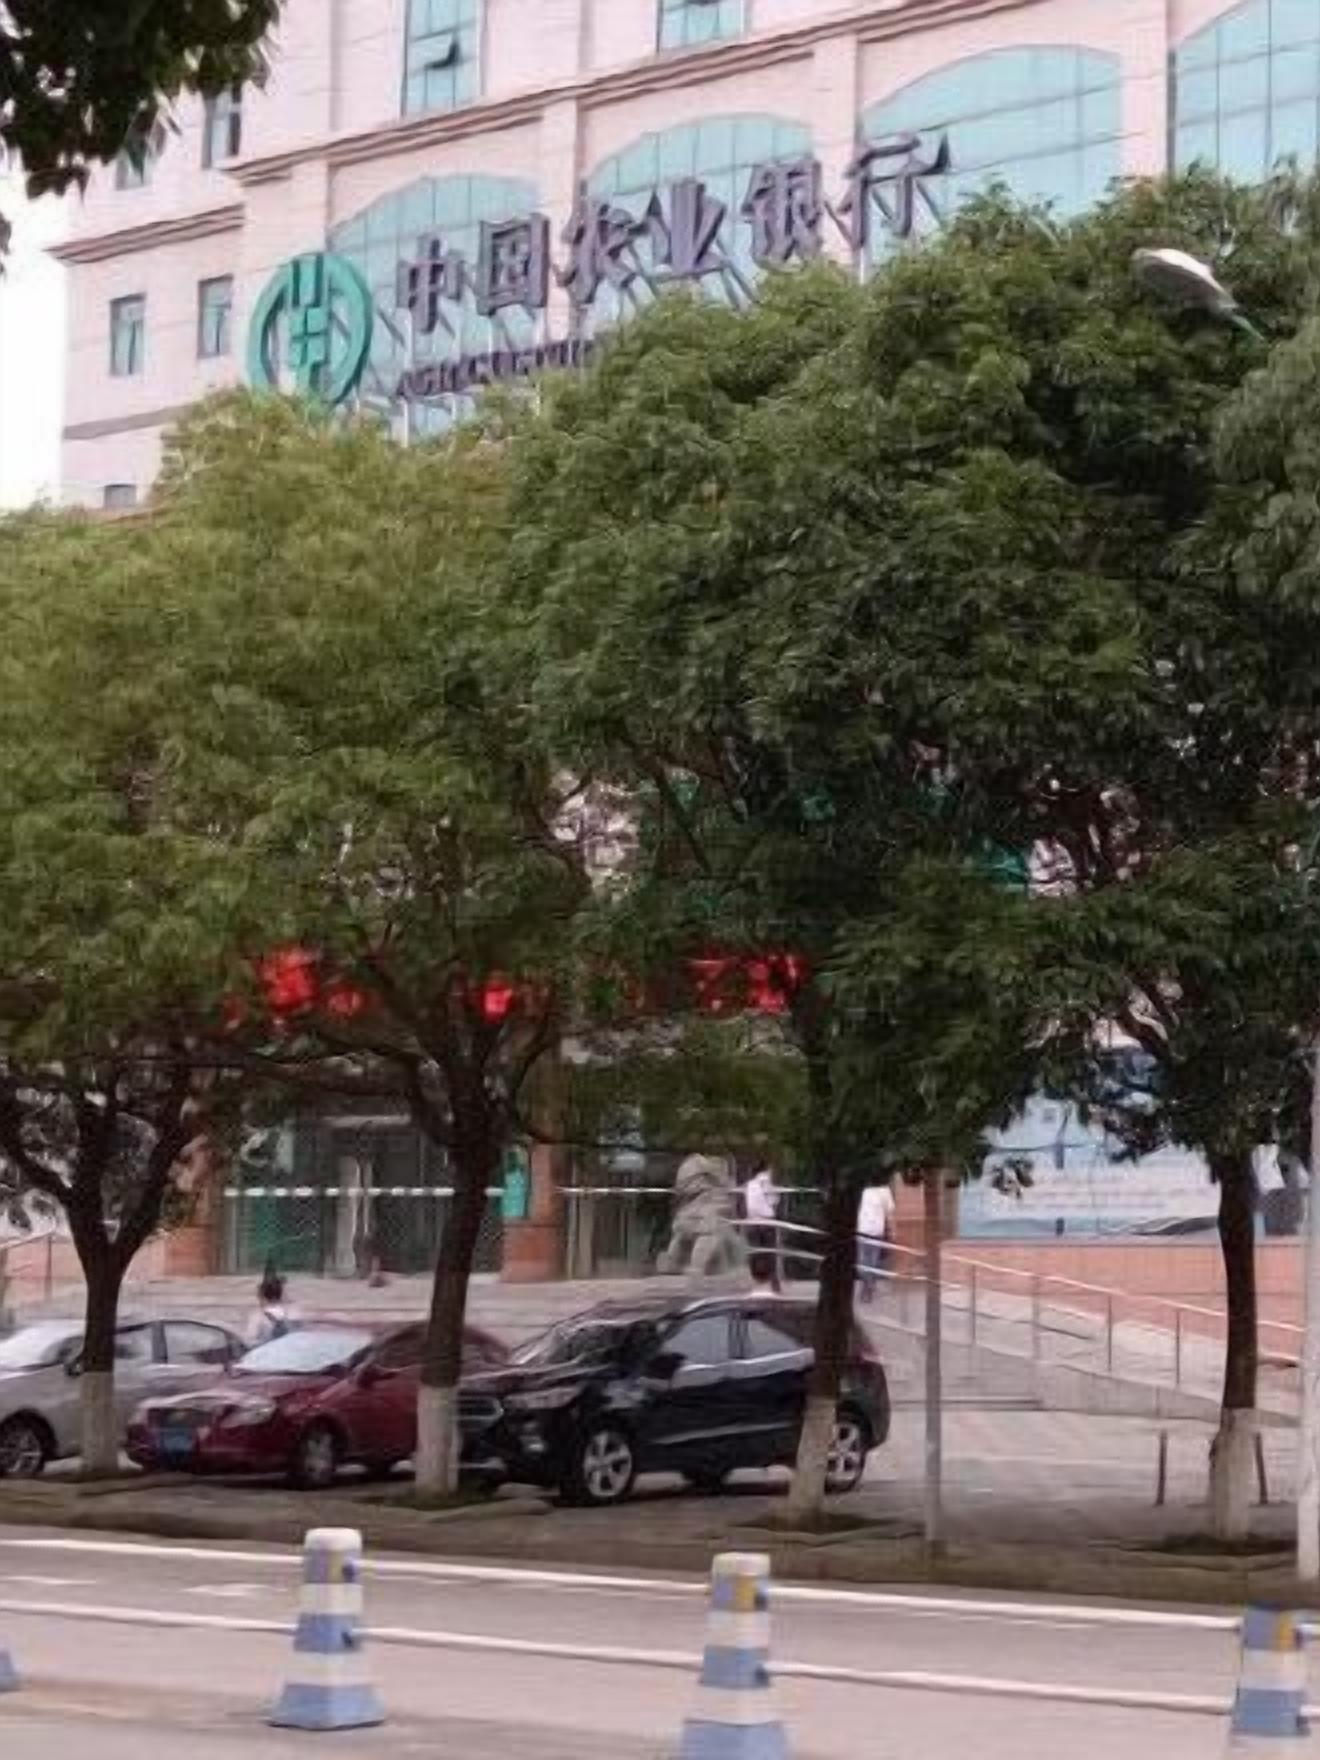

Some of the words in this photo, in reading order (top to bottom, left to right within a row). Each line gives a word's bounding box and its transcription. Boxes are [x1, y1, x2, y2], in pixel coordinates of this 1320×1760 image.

[397, 132, 951, 335] 中国农业银行
